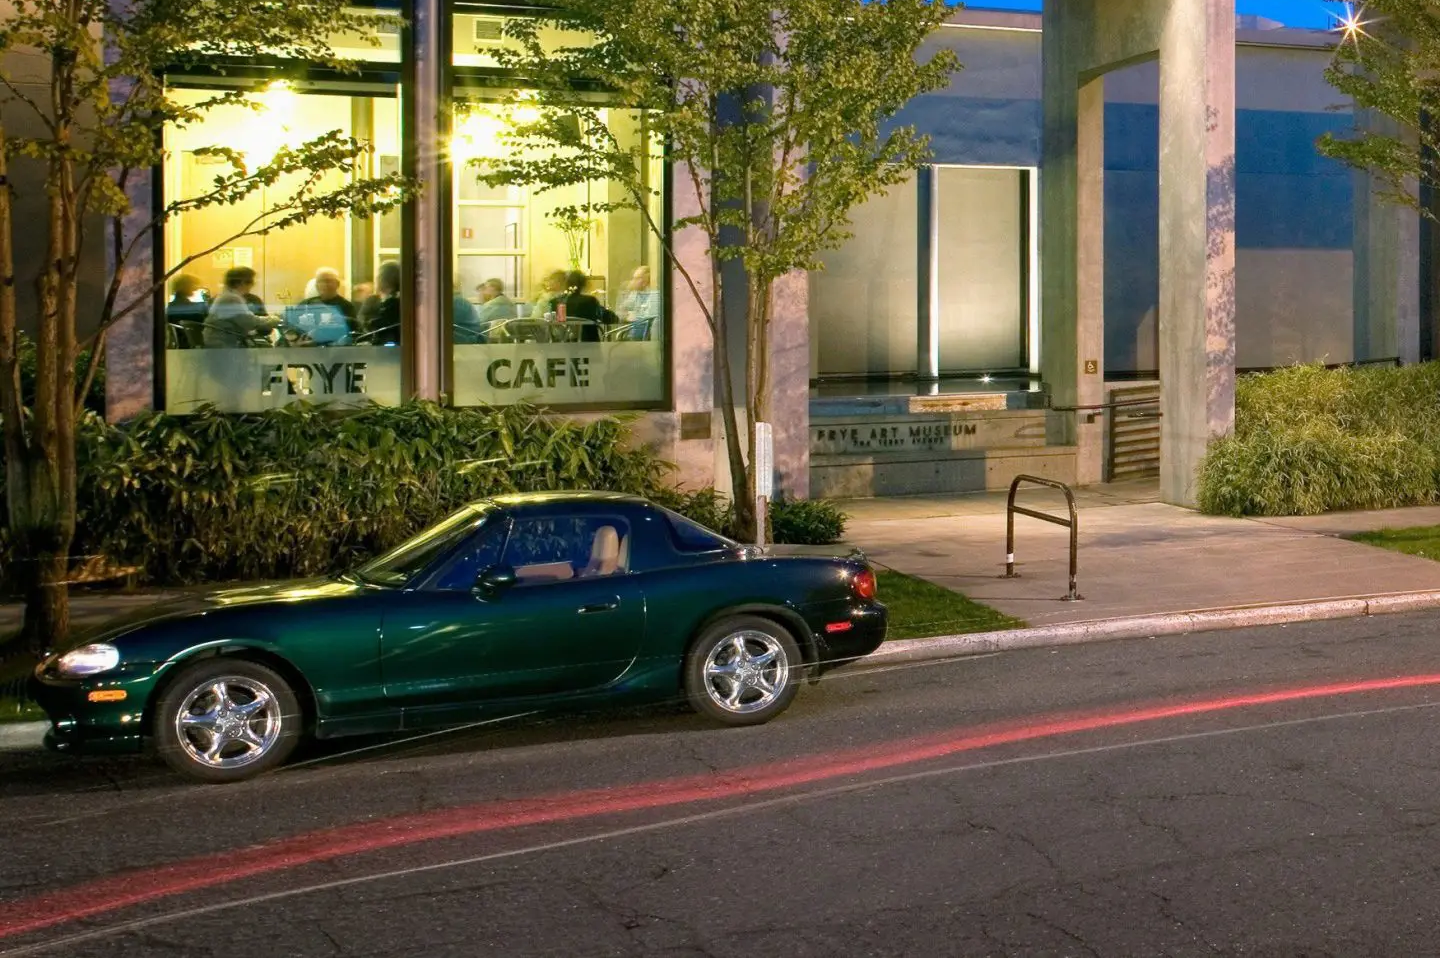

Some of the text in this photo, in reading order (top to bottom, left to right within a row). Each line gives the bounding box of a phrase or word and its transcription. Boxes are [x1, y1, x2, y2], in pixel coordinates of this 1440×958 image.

[261, 357, 590, 396] FRYE CAFE
[817, 424, 977, 441] FRYE ART MUSEUM
